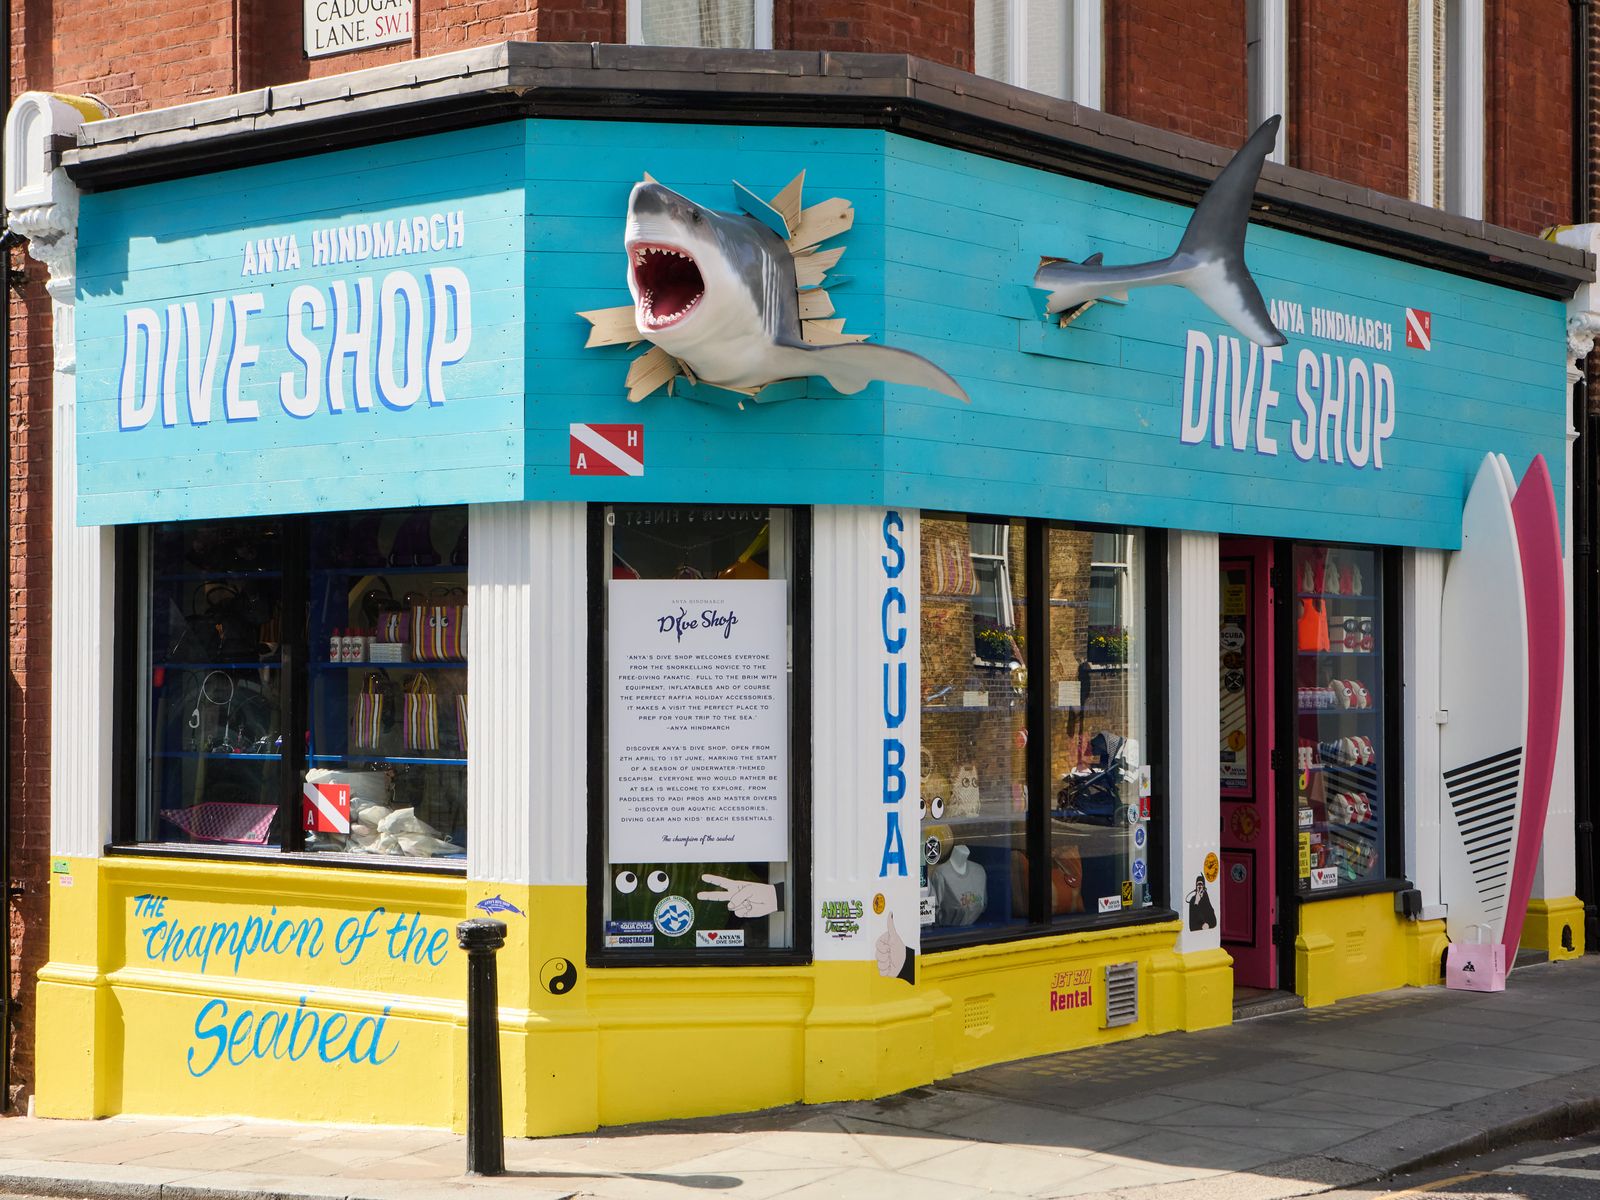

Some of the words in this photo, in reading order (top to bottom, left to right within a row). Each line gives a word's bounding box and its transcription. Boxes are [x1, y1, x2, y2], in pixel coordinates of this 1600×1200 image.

[316, 0, 412, 22] CADOG
[241, 233, 300, 278] ANYA
[312, 210, 464, 267] HINDMARCH
[1269, 298, 1304, 335] ANYA
[1311, 306, 1392, 352] HINDMARCH
[1407, 330, 1413, 343] A
[118, 292, 264, 433] DIVE
[279, 267, 472, 420] SHOP
[1180, 329, 1284, 456] DIVE
[1291, 348, 1396, 470] SHOP
[627, 430, 638, 447] H
[576, 452, 588, 470] A
[702, 610, 738, 640] Shop
[878, 510, 908, 878] SCUBA
[338, 790, 347, 806] H
[307, 810, 314, 826] A
[672, 836, 698, 846] champion
[699, 835, 707, 845] of
[706, 834, 715, 842] the
[134, 894, 168, 918] THE
[821, 900, 864, 919] ANYA'S
[142, 905, 324, 974] Champion
[334, 906, 386, 966] of
[386, 912, 450, 967] the
[618, 936, 652, 944] CRUSTACEAN
[1051, 970, 1072, 988] JET
[1074, 968, 1092, 985] SKI
[1050, 986, 1093, 1012] Rental
[187, 989, 400, 1078] Seabed
